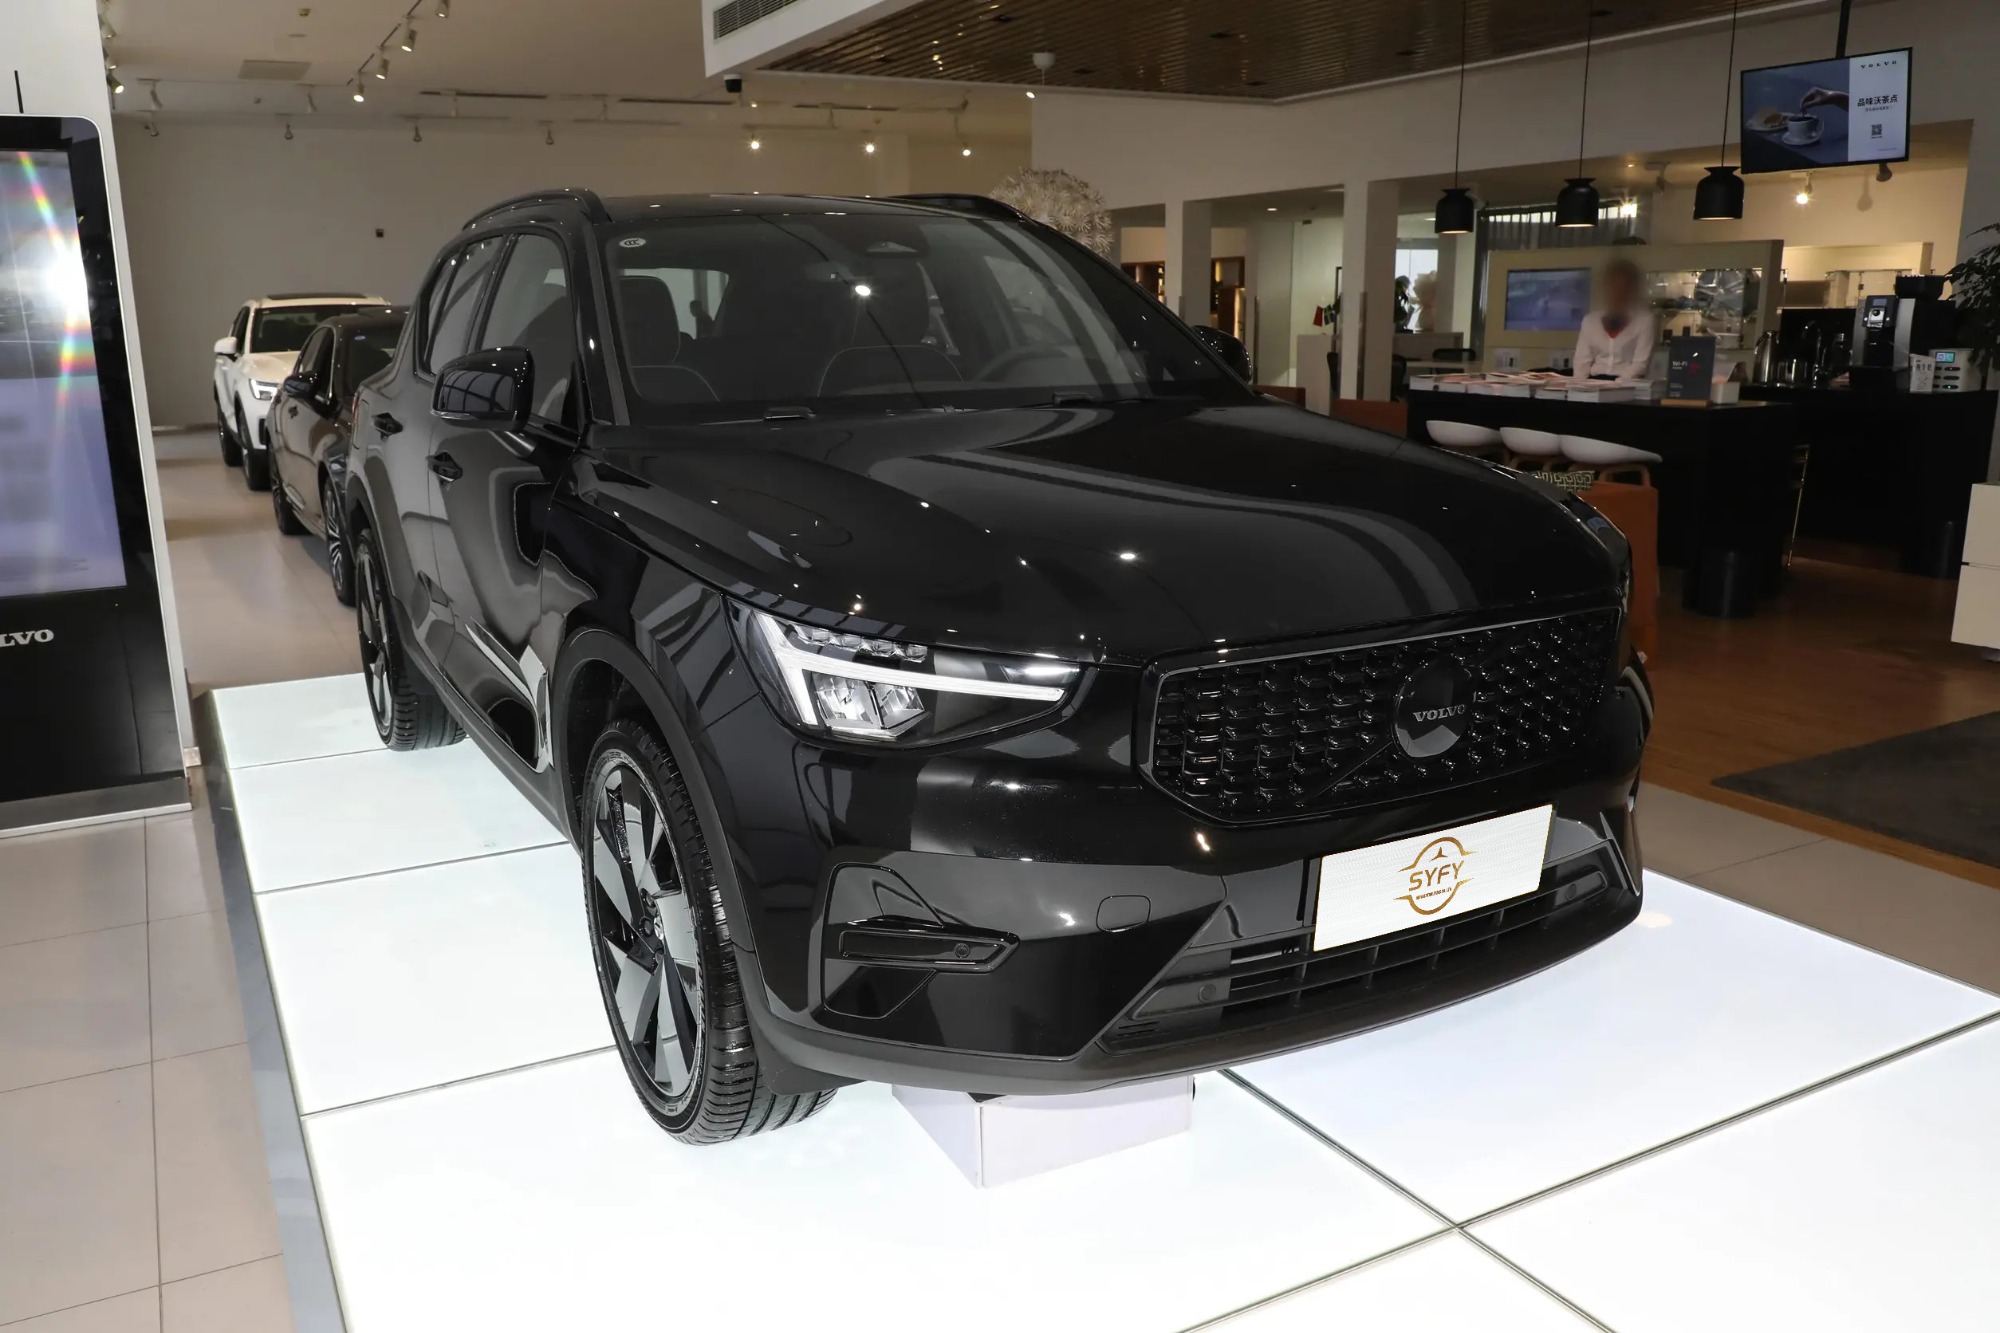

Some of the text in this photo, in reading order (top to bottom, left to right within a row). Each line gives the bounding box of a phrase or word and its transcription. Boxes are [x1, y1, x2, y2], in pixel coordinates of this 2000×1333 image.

[1861, 60, 1897, 69] VOLVO
[1857, 94, 1898, 107] 品味沃茶点
[1413, 704, 1465, 722] VOLVO
[1408, 860, 1464, 892] SYFY
